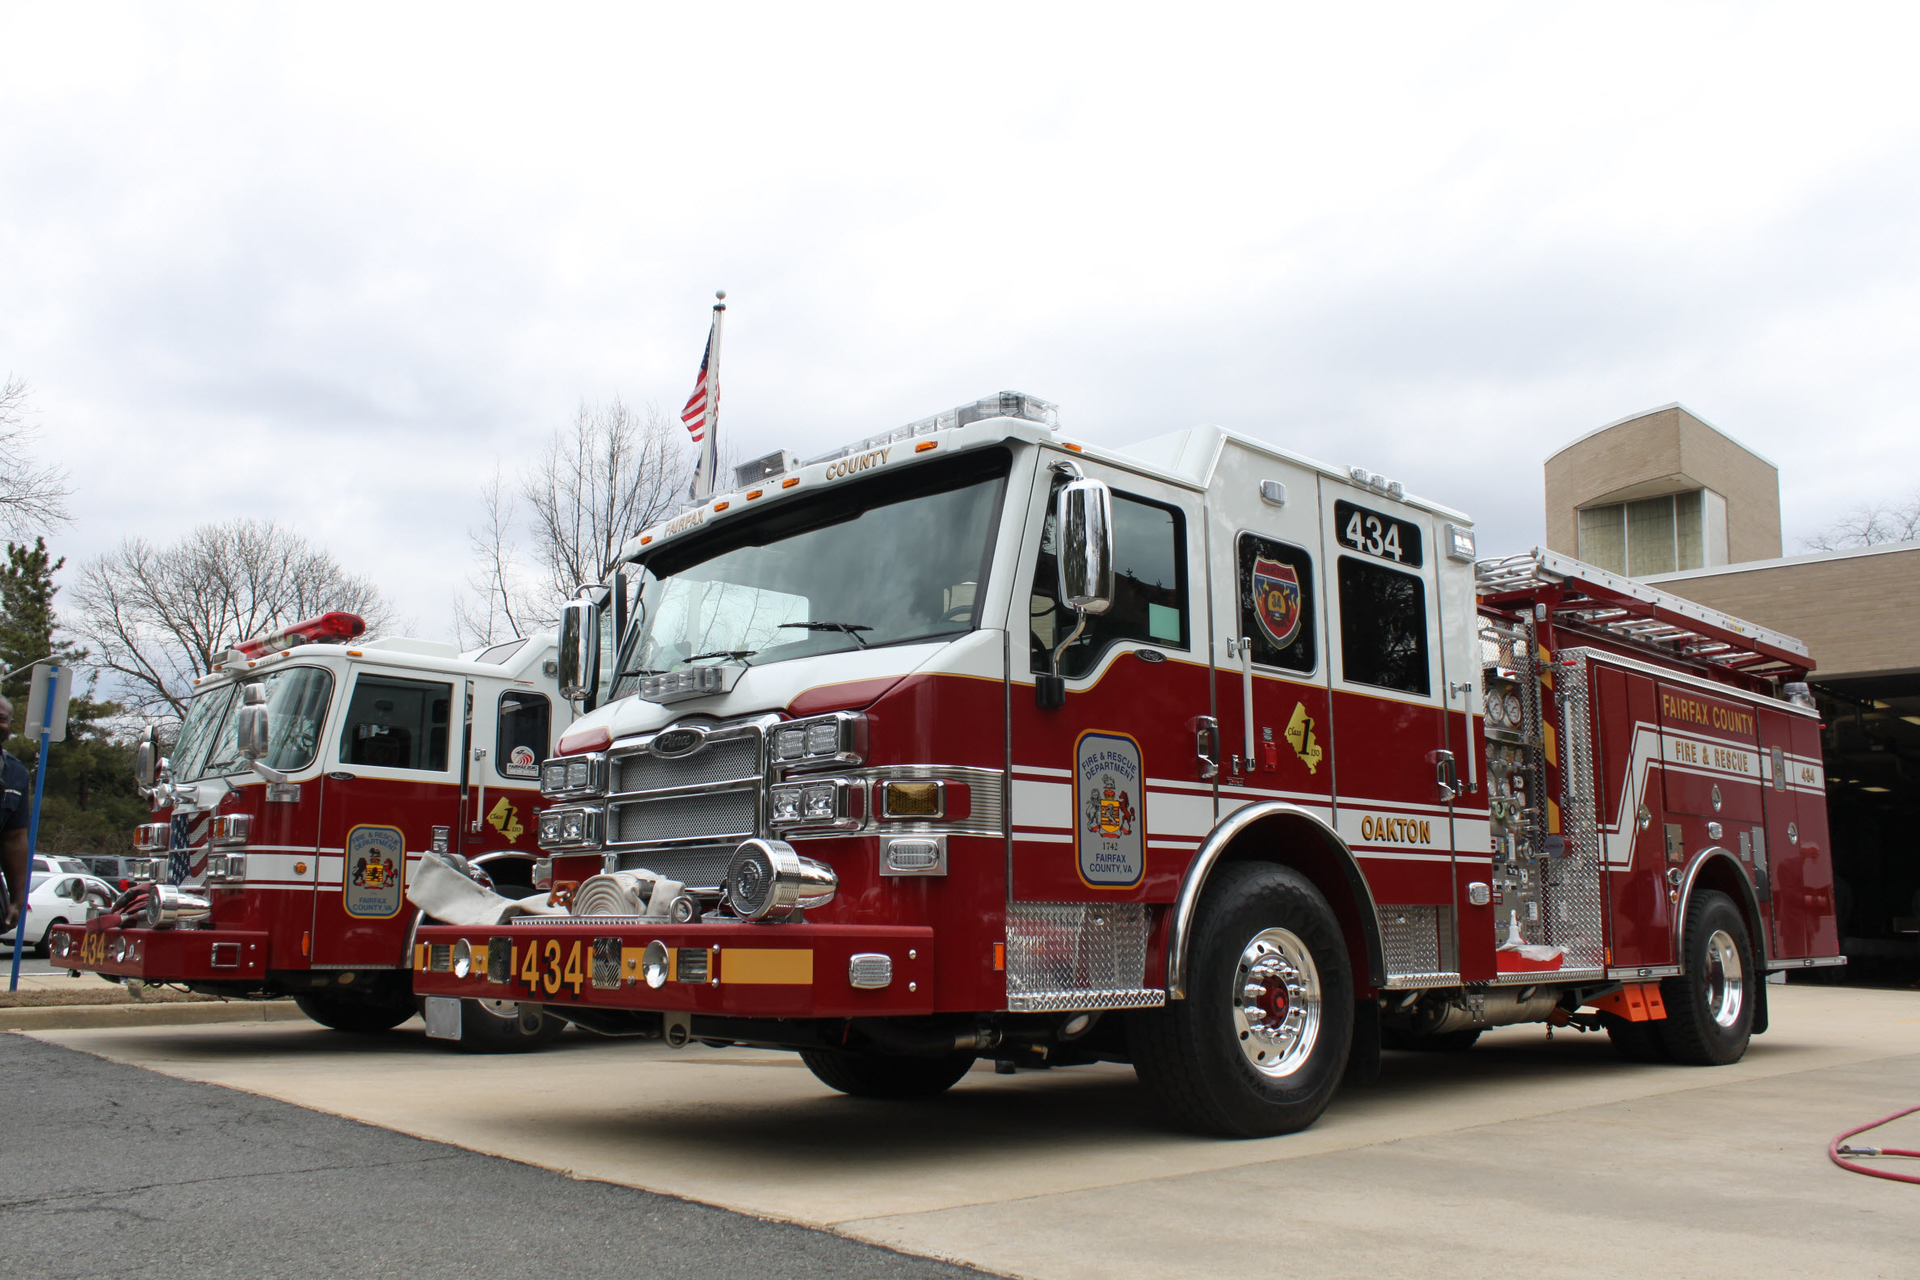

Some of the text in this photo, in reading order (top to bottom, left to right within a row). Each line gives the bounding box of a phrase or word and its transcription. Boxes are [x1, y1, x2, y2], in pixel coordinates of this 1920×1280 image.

[664, 447, 892, 537] FAIRFAX COUNTY
[1346, 511, 1403, 561] 434
[1260, 564, 1292, 579] OAKTON
[1662, 694, 1754, 735] FAIRFAX COUNTY
[1298, 718, 1311, 756] 1
[1081, 751, 1137, 774] FIRE & RESCUE
[1675, 740, 1697, 764] FIRE
[1702, 745, 1709, 765] &
[1714, 747, 1748, 772] RESCUE
[1085, 761, 1135, 782] DEPARTMENT
[1801, 766, 1815, 784] 434
[499, 807, 514, 832] 1
[1361, 815, 1431, 844] OAKTON
[351, 833, 366, 845] FIRE
[374, 831, 400, 846] RESCUE
[354, 838, 397, 852] DEPARTMENT
[1102, 842, 1118, 851] 1742
[1095, 853, 1127, 863] FAIRFAX
[358, 897, 387, 905] FAIRFAX
[80, 932, 106, 966] 434
[519, 939, 584, 998] 434
